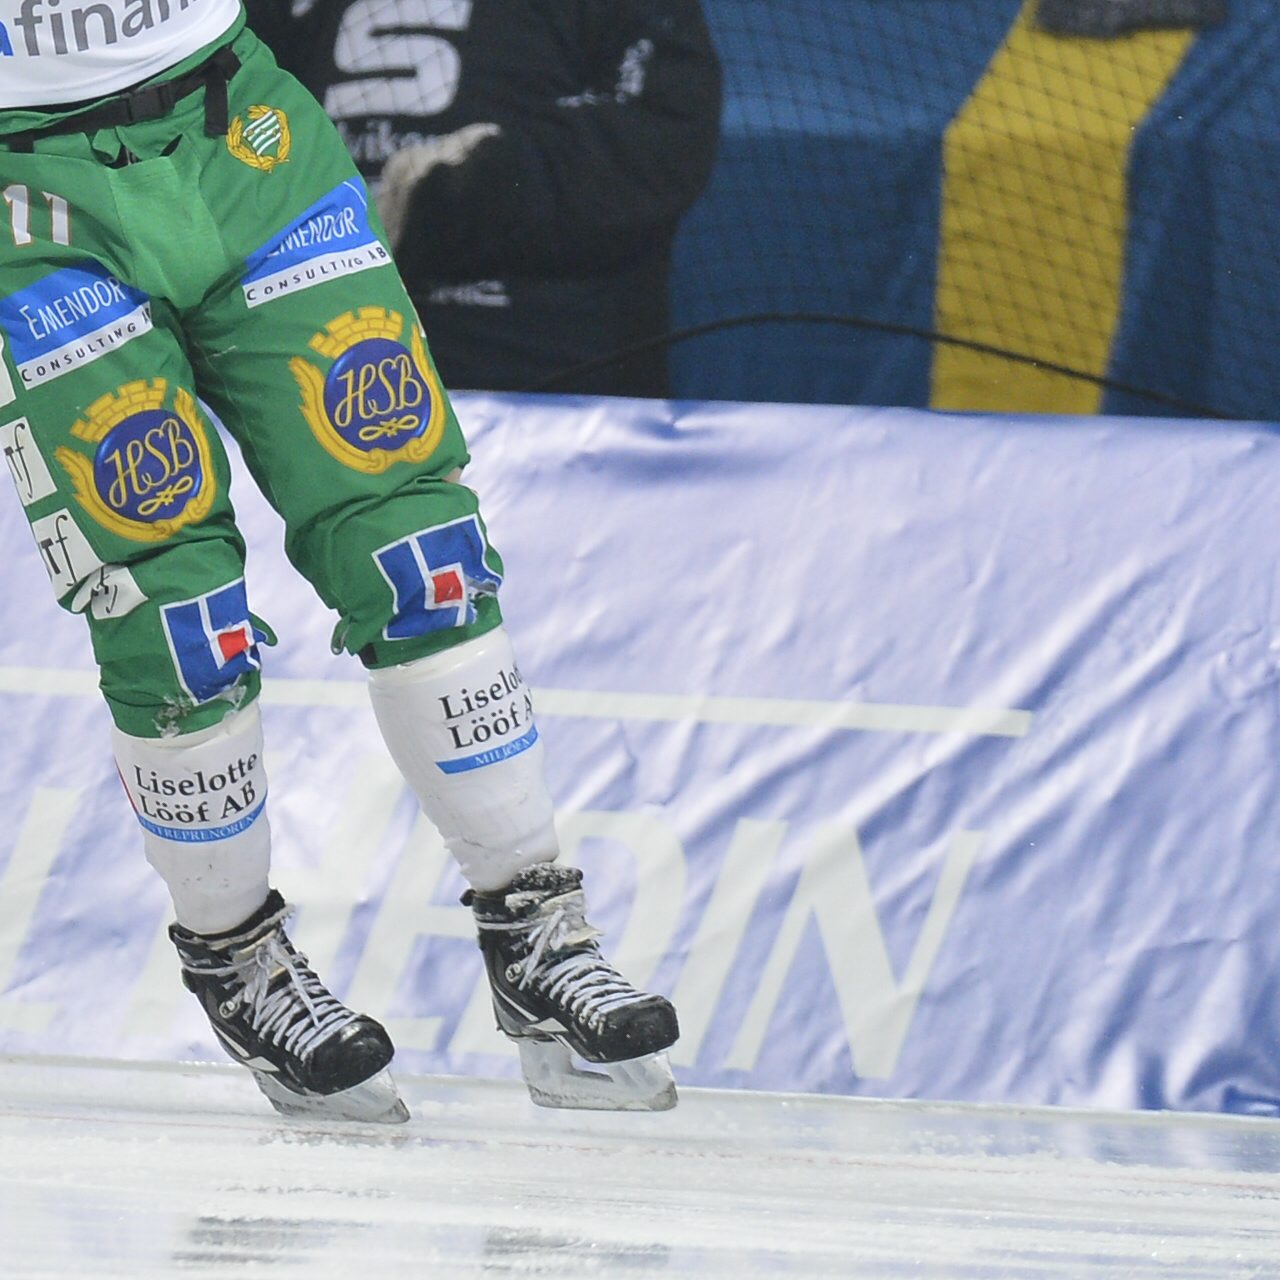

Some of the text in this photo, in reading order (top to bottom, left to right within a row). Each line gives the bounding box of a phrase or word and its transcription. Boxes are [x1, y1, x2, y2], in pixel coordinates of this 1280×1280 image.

[1, 183, 72, 248] 11
[367, 246, 387, 261] AB
[19, 275, 127, 341] EMENDOR
[21, 321, 137, 382] CONSULTING
[334, 356, 423, 428] HSB
[104, 418, 194, 508] HSB
[446, 701, 521, 750] Lööf
[134, 752, 258, 796] Liselotte
[138, 779, 256, 824] Lööf AB
